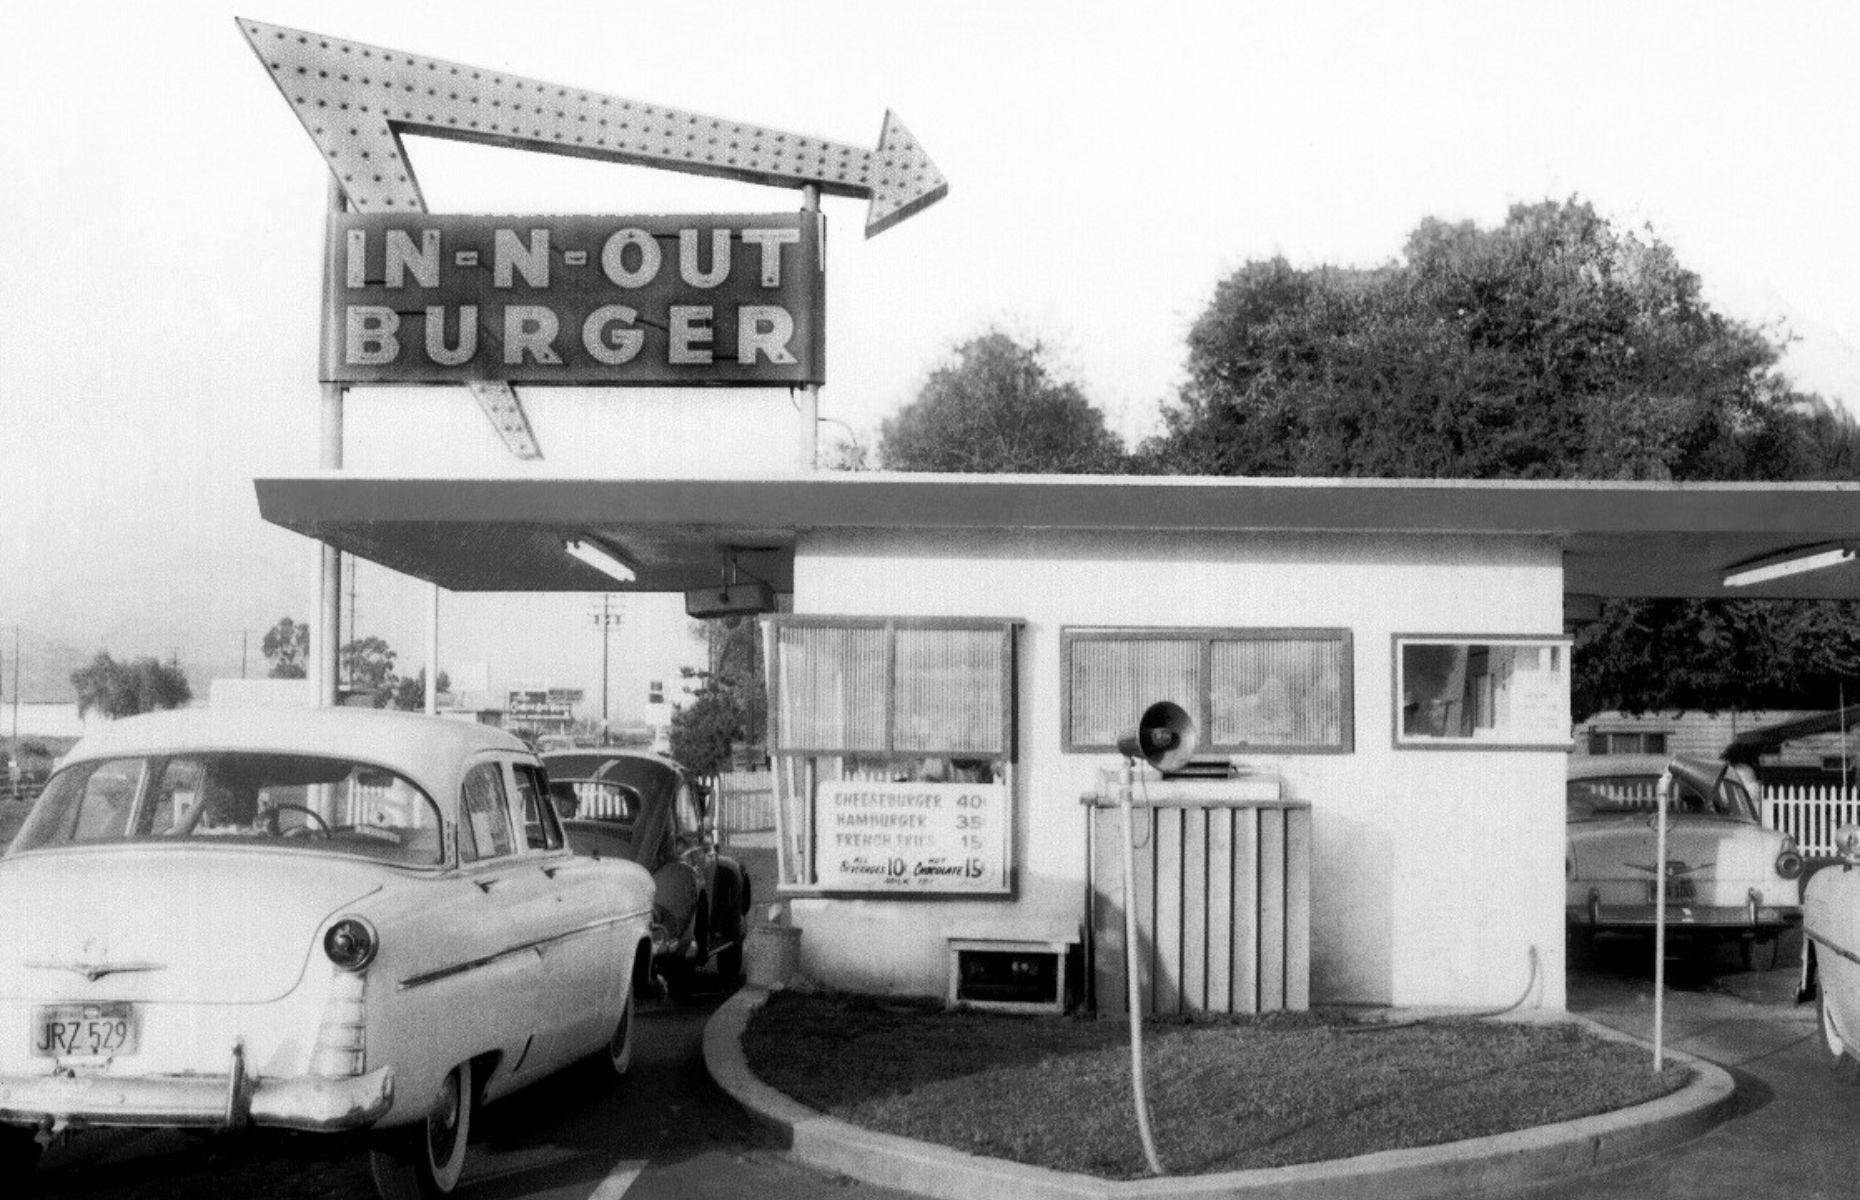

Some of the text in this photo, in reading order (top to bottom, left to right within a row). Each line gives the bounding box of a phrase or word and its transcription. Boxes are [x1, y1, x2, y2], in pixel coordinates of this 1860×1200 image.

[347, 229, 800, 288] IN-N-OUT
[345, 304, 798, 365] BURGER
[834, 792, 943, 807] CHEESEBURGER
[836, 812, 928, 828] HAMBURGER
[835, 832, 892, 847] FRENCH
[36, 1020, 127, 1051] JRZ 529
